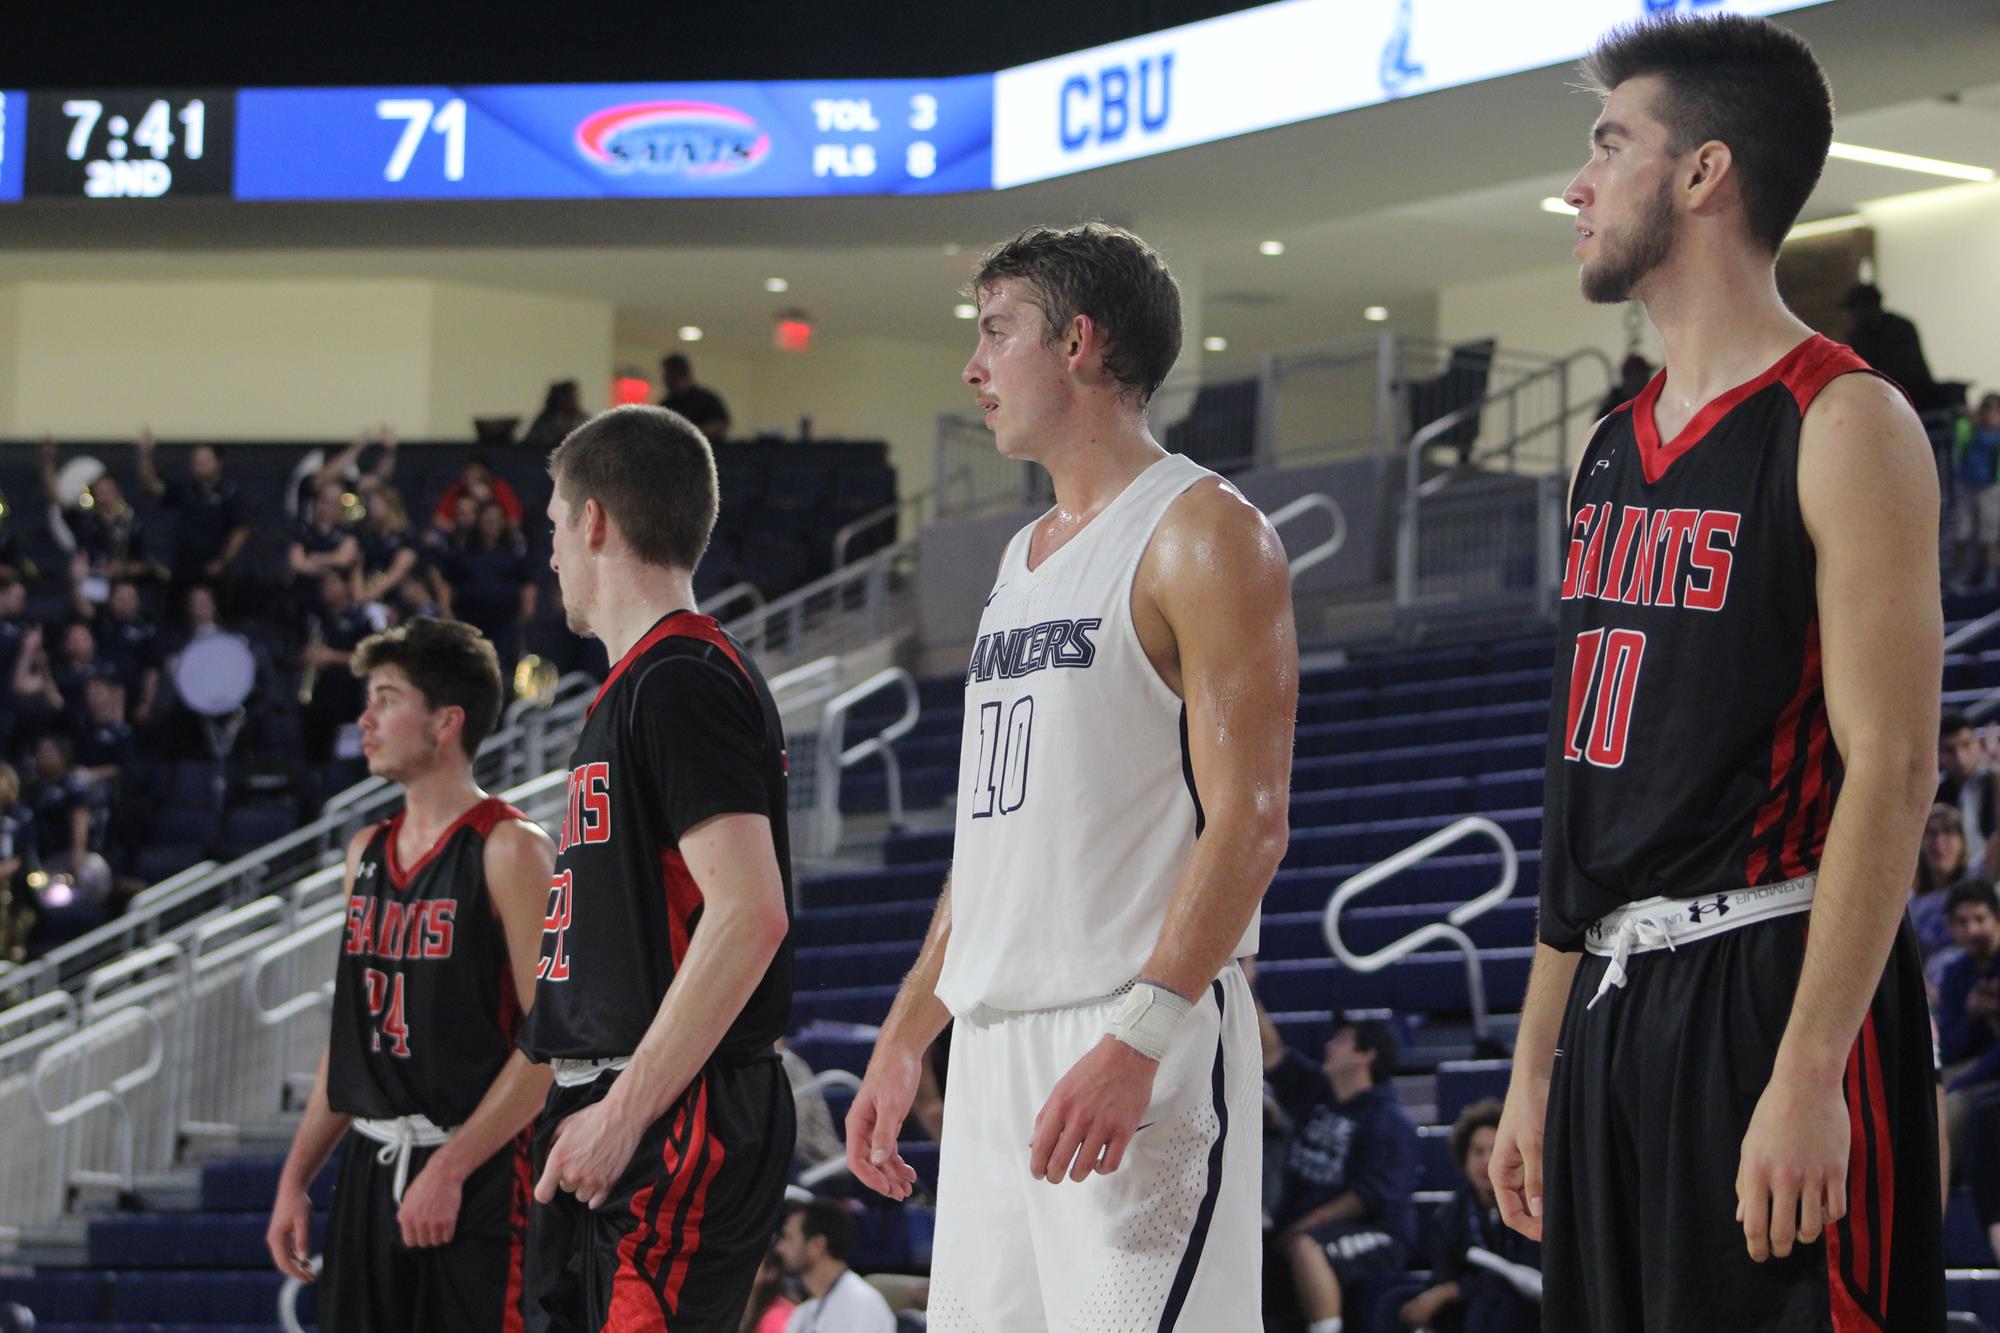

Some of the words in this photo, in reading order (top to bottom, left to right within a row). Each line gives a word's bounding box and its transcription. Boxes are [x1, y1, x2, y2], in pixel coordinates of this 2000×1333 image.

[63, 99, 205, 160] 7:41
[812, 98, 880, 133] TOL
[908, 93, 938, 132] 3
[1058, 51, 1175, 151] CBU
[376, 98, 467, 182] 71
[813, 143, 876, 178] FLS
[85, 160, 171, 197] 2ND
[1561, 501, 1741, 612] SAINTS
[964, 618, 1102, 688] ANCERS
[1564, 626, 1646, 769] 10
[972, 695, 1034, 819] 10
[1735, 880, 1806, 906] ARMOUR
[346, 895, 457, 959] SAINTS
